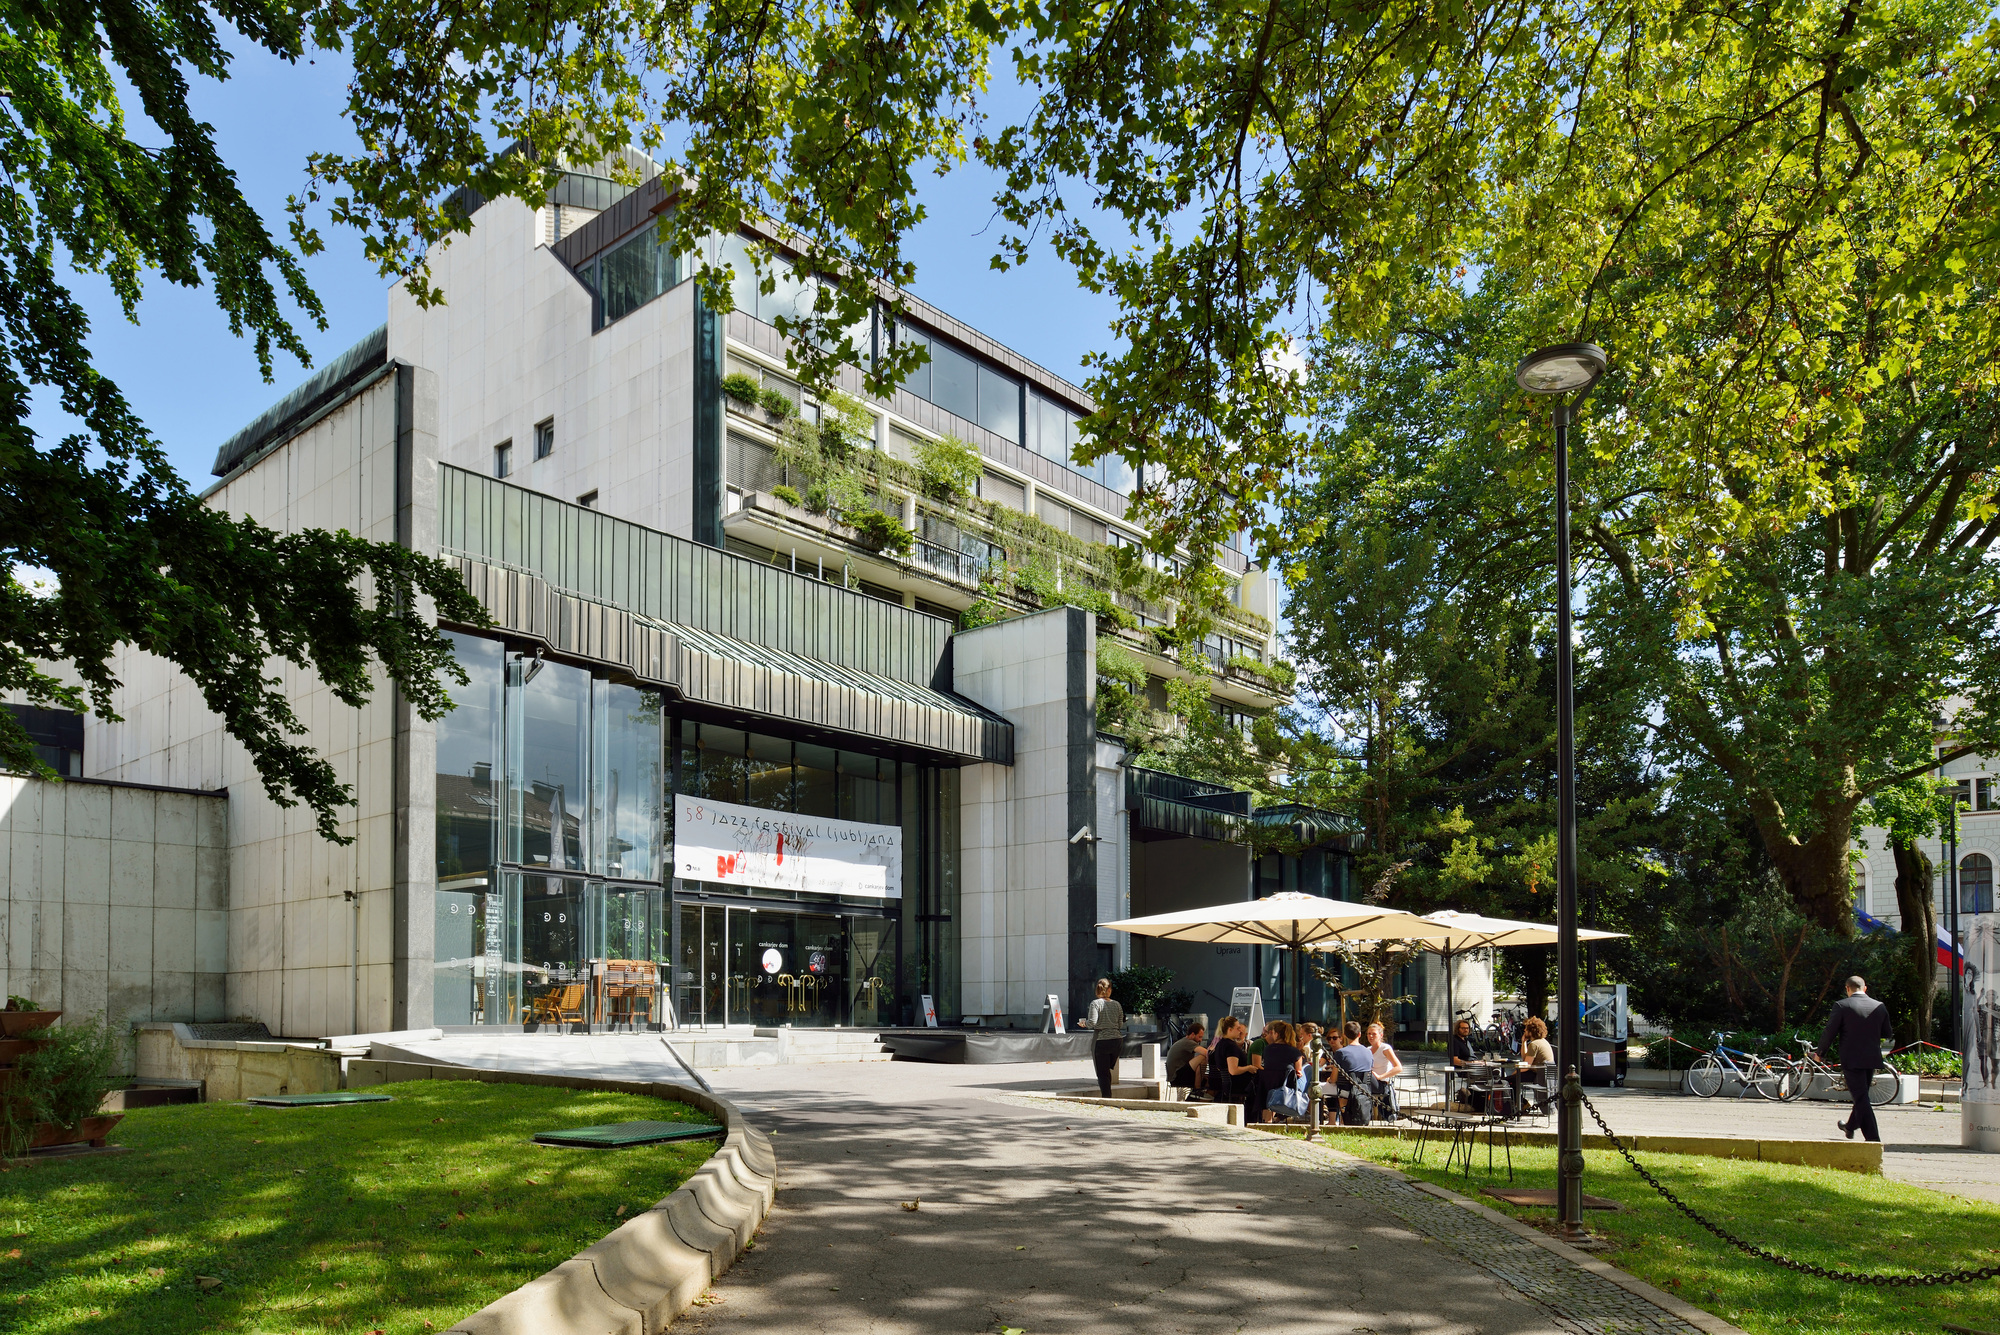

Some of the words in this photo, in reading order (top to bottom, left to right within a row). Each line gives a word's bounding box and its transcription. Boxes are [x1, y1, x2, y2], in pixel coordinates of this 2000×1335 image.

[686, 806, 704, 823] 58
[711, 810, 748, 828] jazz
[755, 816, 820, 838] festival
[827, 826, 894, 846] ljubljana
[758, 941, 778, 949] cankarjev
[1216, 946, 1241, 956] Uprava
[1976, 1125, 2000, 1134] cankar
